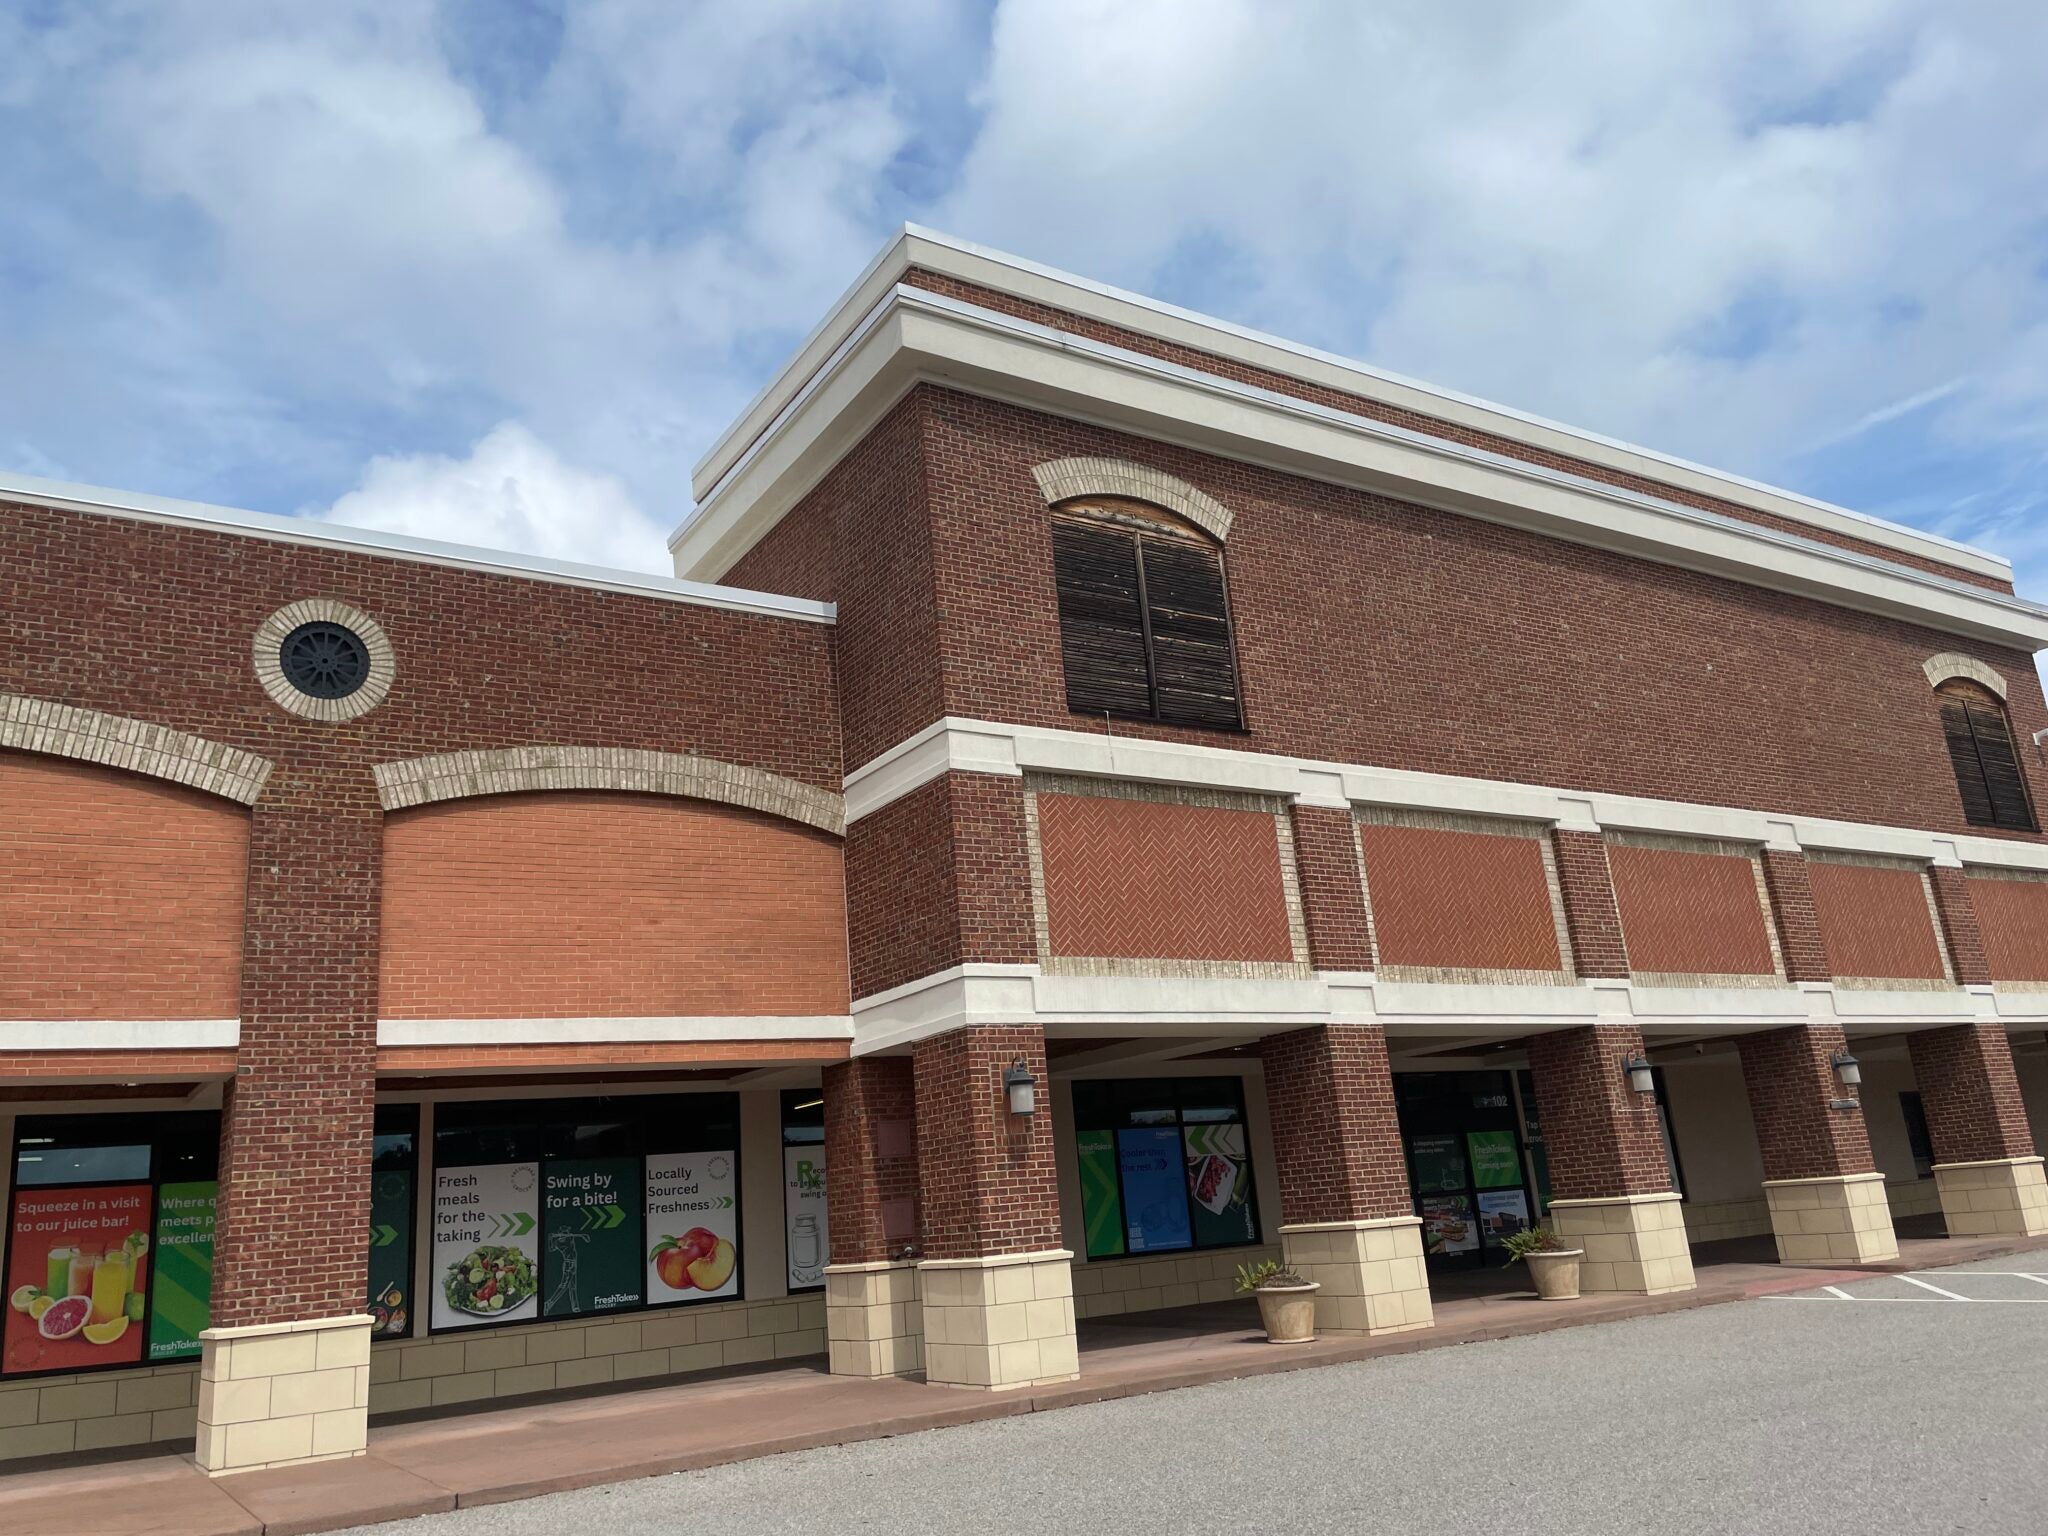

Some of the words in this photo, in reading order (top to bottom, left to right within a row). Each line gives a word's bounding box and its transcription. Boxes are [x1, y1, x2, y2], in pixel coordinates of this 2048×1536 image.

[439, 1174, 477, 1187] Fresh
[547, 1174, 590, 1189] Swing
[594, 1172, 612, 1188] by
[648, 1167, 692, 1180] Locally
[648, 1182, 699, 1197] Sourced
[18, 1199, 79, 1215] Squeeze
[82, 1198, 96, 1210] in
[99, 1200, 107, 1209] a
[111, 1197, 140, 1208] visit
[161, 1197, 205, 1209] Where
[208, 1199, 216, 1211] q
[438, 1192, 480, 1206] meals
[547, 1195, 569, 1208] for
[572, 1196, 581, 1206] a
[584, 1191, 617, 1206] bite!
[648, 1200, 710, 1214] Freshness
[16, 1221, 32, 1232] to
[35, 1221, 60, 1231] our
[63, 1217, 98, 1232] juice
[101, 1216, 129, 1227] bar!
[160, 1215, 202, 1227] meets
[437, 1212, 458, 1224] for
[462, 1210, 485, 1222] the
[159, 1232, 215, 1245] excellen
[437, 1229, 481, 1243] taking
[594, 1293, 634, 1304] FreshTake
